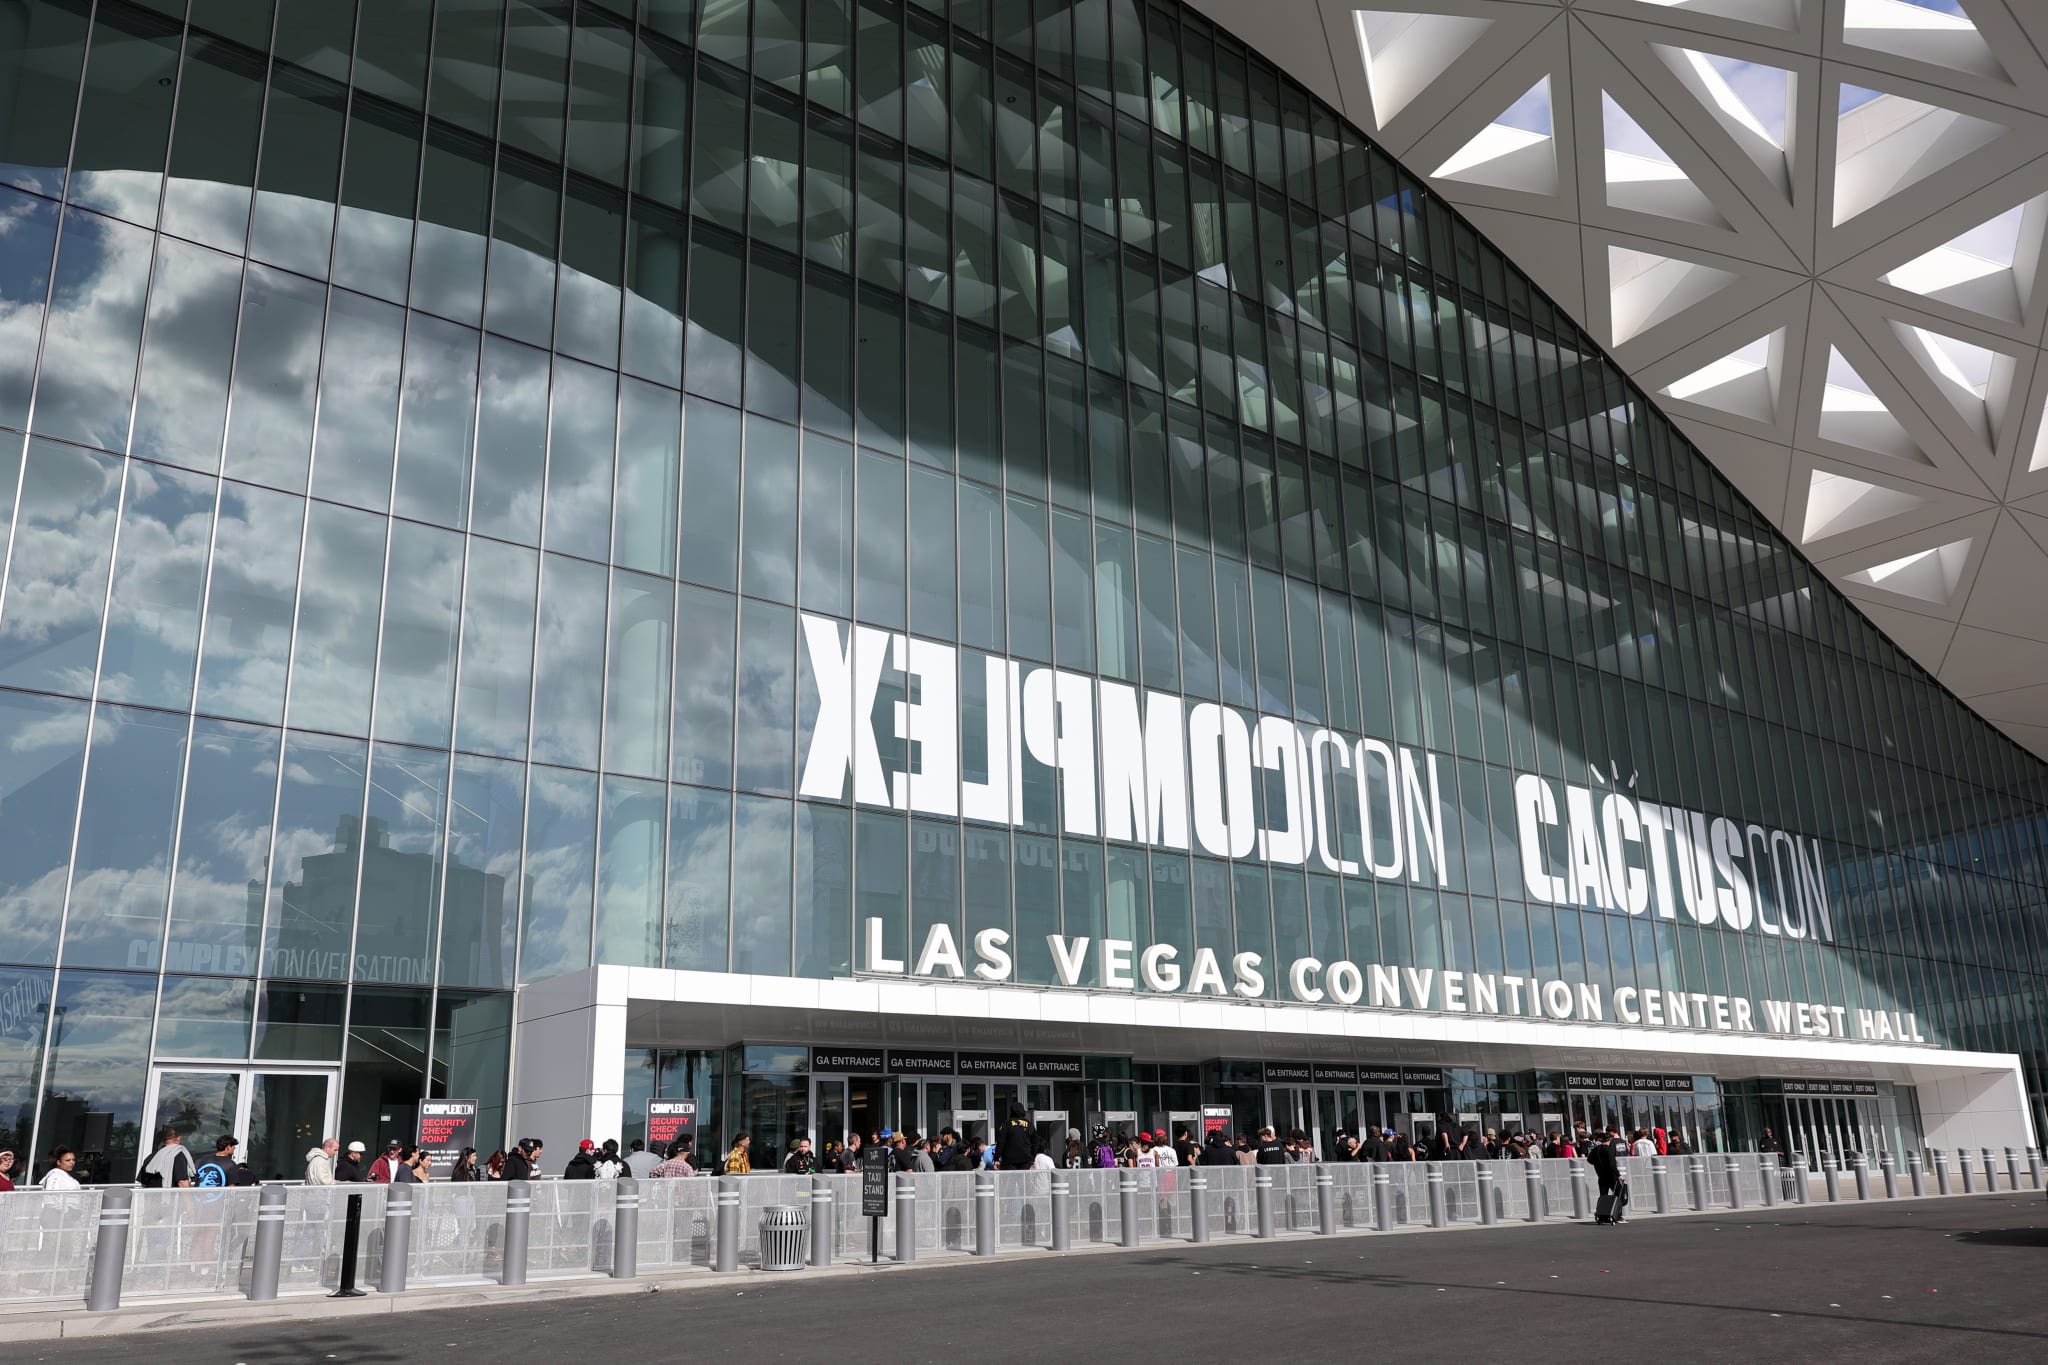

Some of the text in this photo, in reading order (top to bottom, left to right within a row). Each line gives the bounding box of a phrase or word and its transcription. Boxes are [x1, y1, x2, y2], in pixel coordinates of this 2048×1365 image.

[865, 916, 1924, 1042] LAS VEGAS CONVENTION CENTER WEST HALL
[816, 1056, 880, 1066] GA ENTRANCE
[891, 1058, 951, 1068] GA ENTRANCE
[960, 1060, 1017, 1070] GA ENTRANCE
[1026, 1062, 1079, 1071] GA ENTRANCE
[1267, 1069, 1309, 1078] GA ENTRANCE
[1315, 1070, 1355, 1079] GA ENTRANCE
[1361, 1071, 1399, 1080] GA ENTRANCE
[1413, 1073, 1440, 1081] ENTRANCE
[1568, 1077, 1596, 1086] EXIT ONLY
[1602, 1078, 1629, 1086] EXIT ONLY
[1647, 1079, 1660, 1087] ONLY
[423, 1104, 474, 1115] COMPLEXCON
[651, 1104, 695, 1114] COMPLEXCON
[868, 1172, 881, 1182] TAXI
[864, 1185, 884, 1195] STAND
